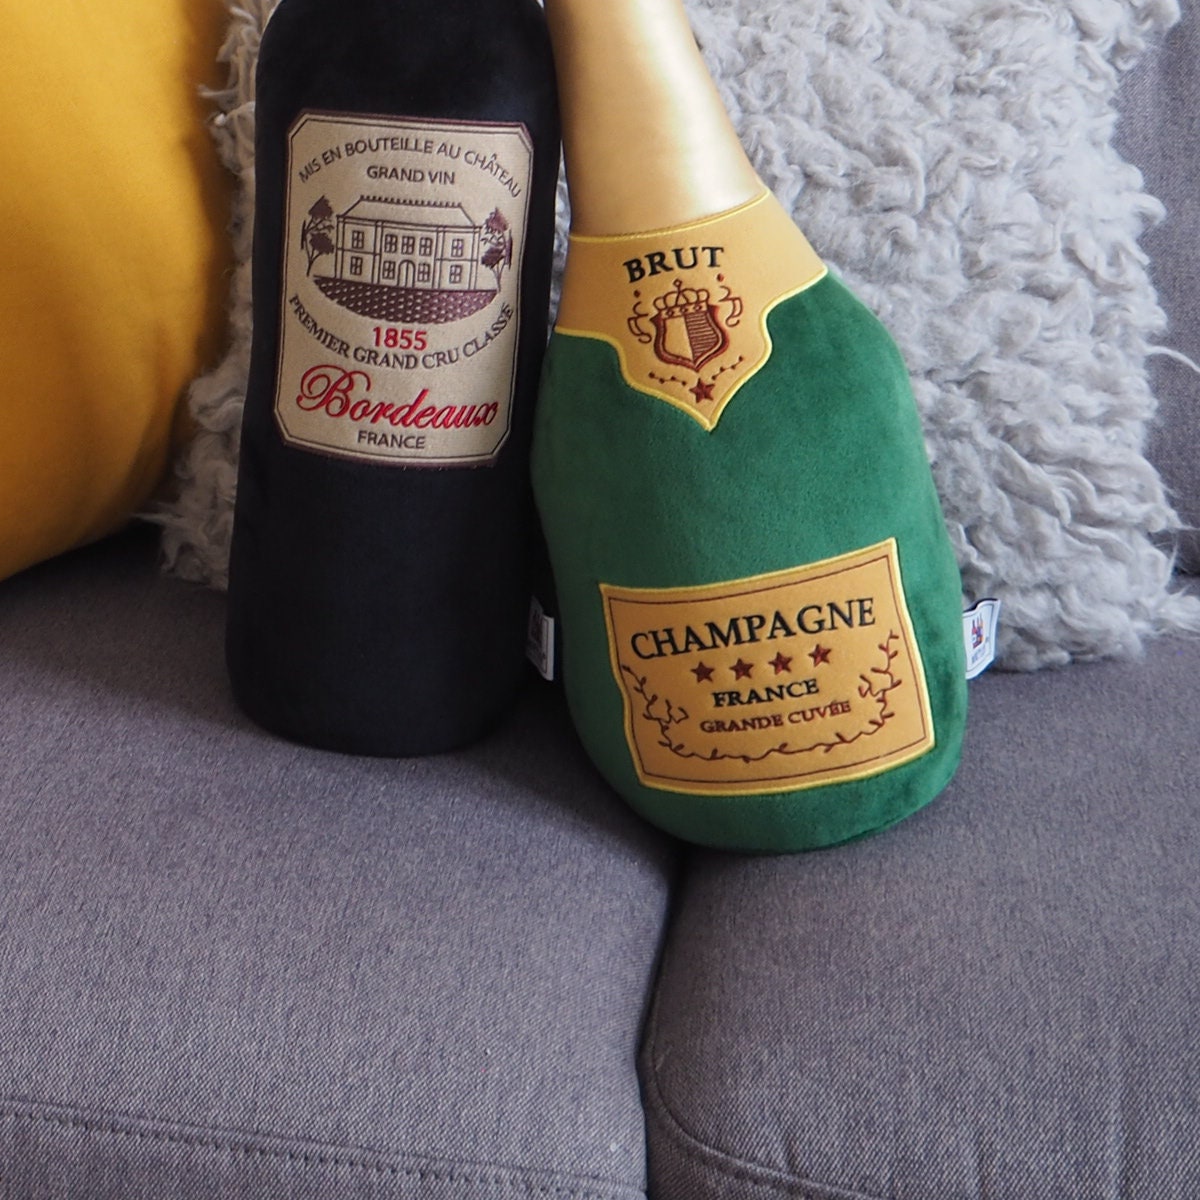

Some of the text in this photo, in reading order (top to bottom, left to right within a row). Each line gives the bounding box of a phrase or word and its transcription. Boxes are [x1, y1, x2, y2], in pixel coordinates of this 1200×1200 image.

[298, 137, 522, 199] MIS EN BOUTEILLE AU CHÂTEAU
[366, 165, 456, 186] GRAND VIN
[623, 247, 724, 283] BRUT
[289, 295, 350, 359] PREMIER
[352, 347, 419, 371] GRAND
[421, 346, 460, 371] CRU
[372, 325, 429, 352] 1855
[296, 364, 499, 429] Bordeaux
[356, 429, 427, 450] FRANCE
[630, 597, 877, 661] CHAMPAGNE
[712, 678, 821, 709] FRANCE
[699, 715, 785, 734] GRANDE
